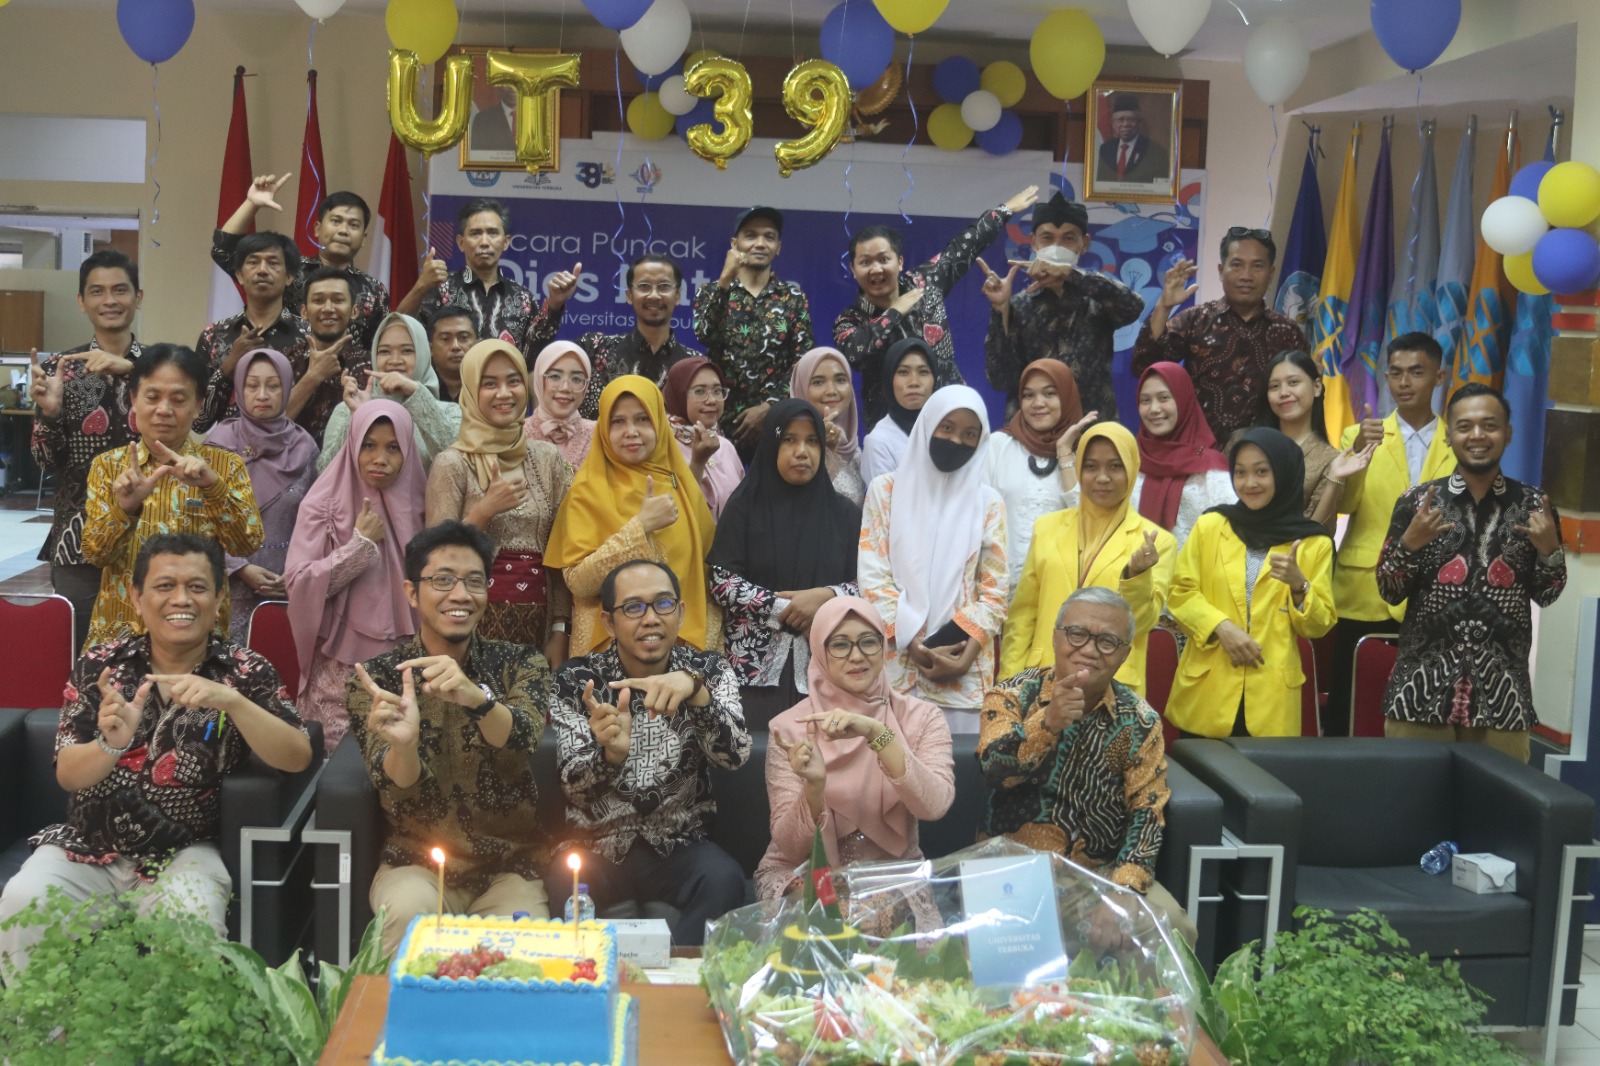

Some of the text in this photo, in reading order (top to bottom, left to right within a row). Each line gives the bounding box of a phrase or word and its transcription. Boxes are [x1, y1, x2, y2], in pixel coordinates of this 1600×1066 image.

[387, 49, 853, 178] UT 39
[510, 232, 707, 260] cara Puncak
[561, 310, 635, 327] iversitas
[988, 933, 1041, 945] UNIVERSITAS
[997, 944, 1035, 953] TERBUKA
